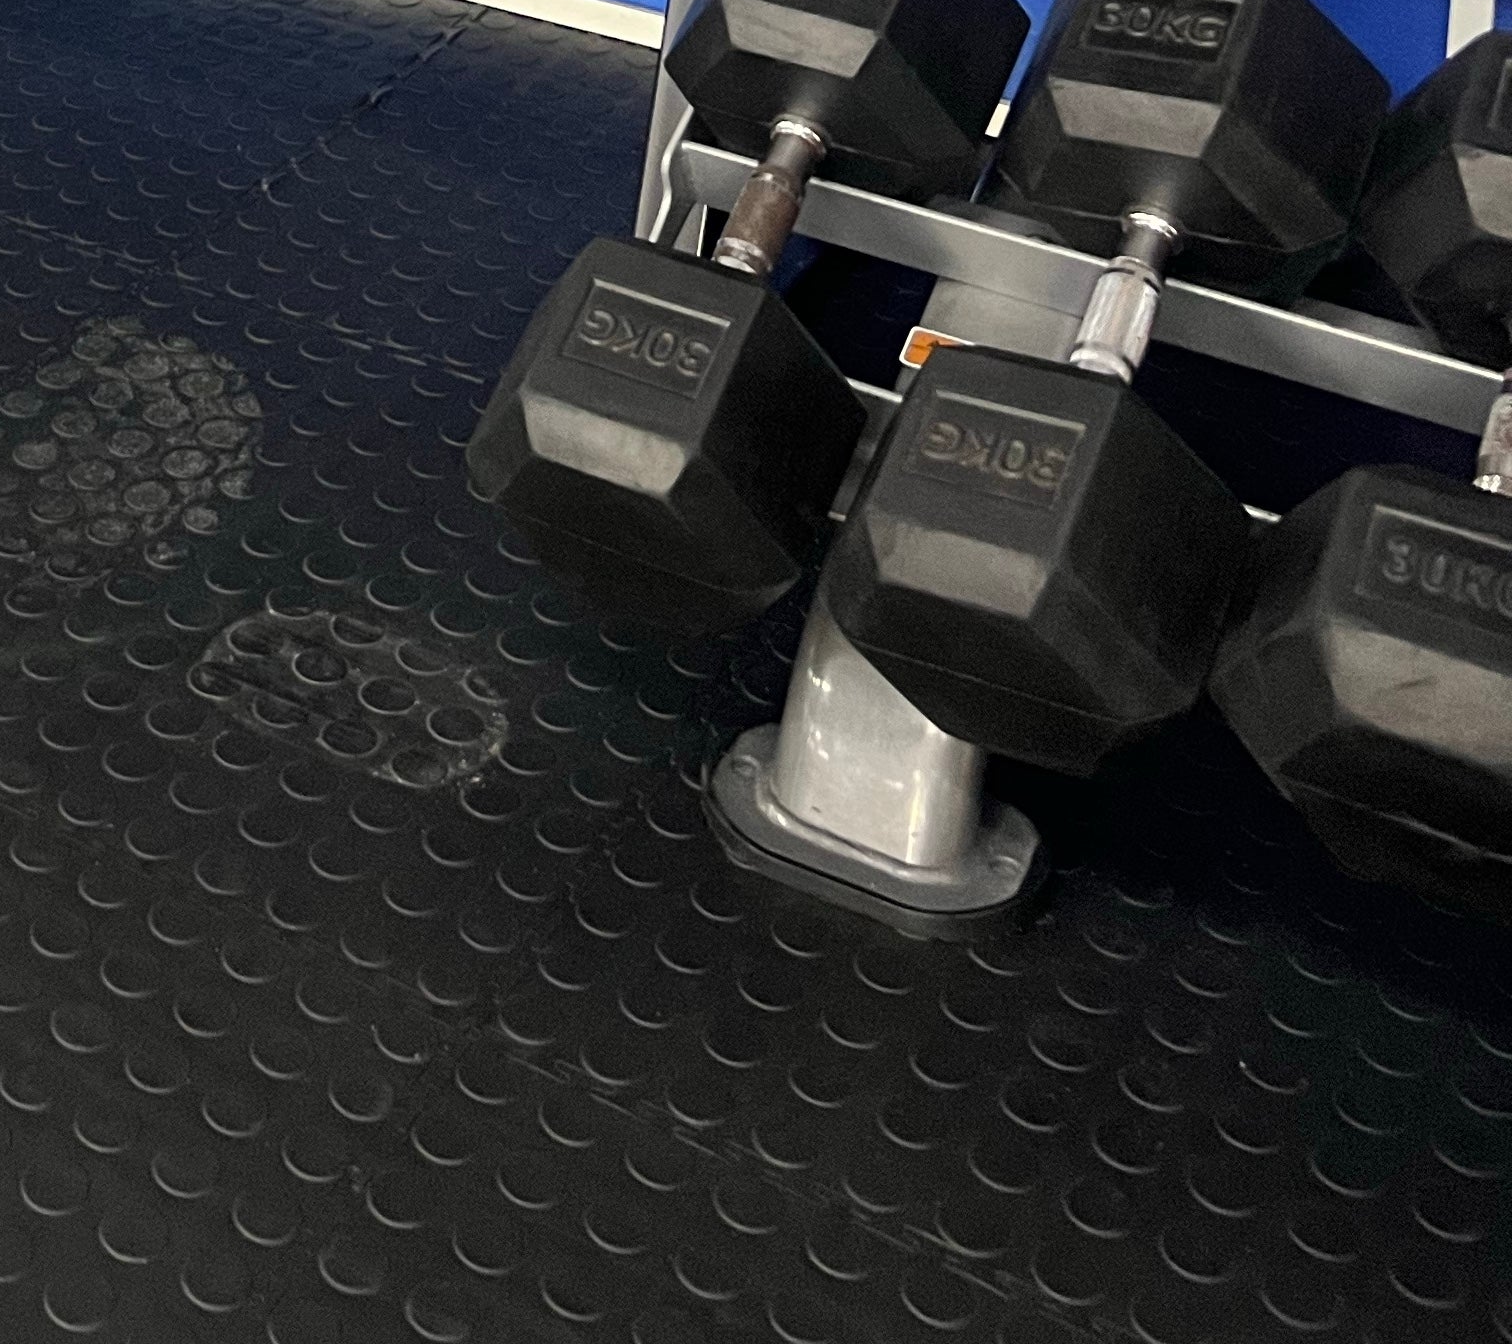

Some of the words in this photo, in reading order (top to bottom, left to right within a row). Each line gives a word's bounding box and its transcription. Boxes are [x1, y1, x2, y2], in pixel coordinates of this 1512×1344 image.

[1093, 1, 1228, 48] 30KG
[577, 309, 712, 378] 30KG
[919, 420, 1067, 489] 30KG
